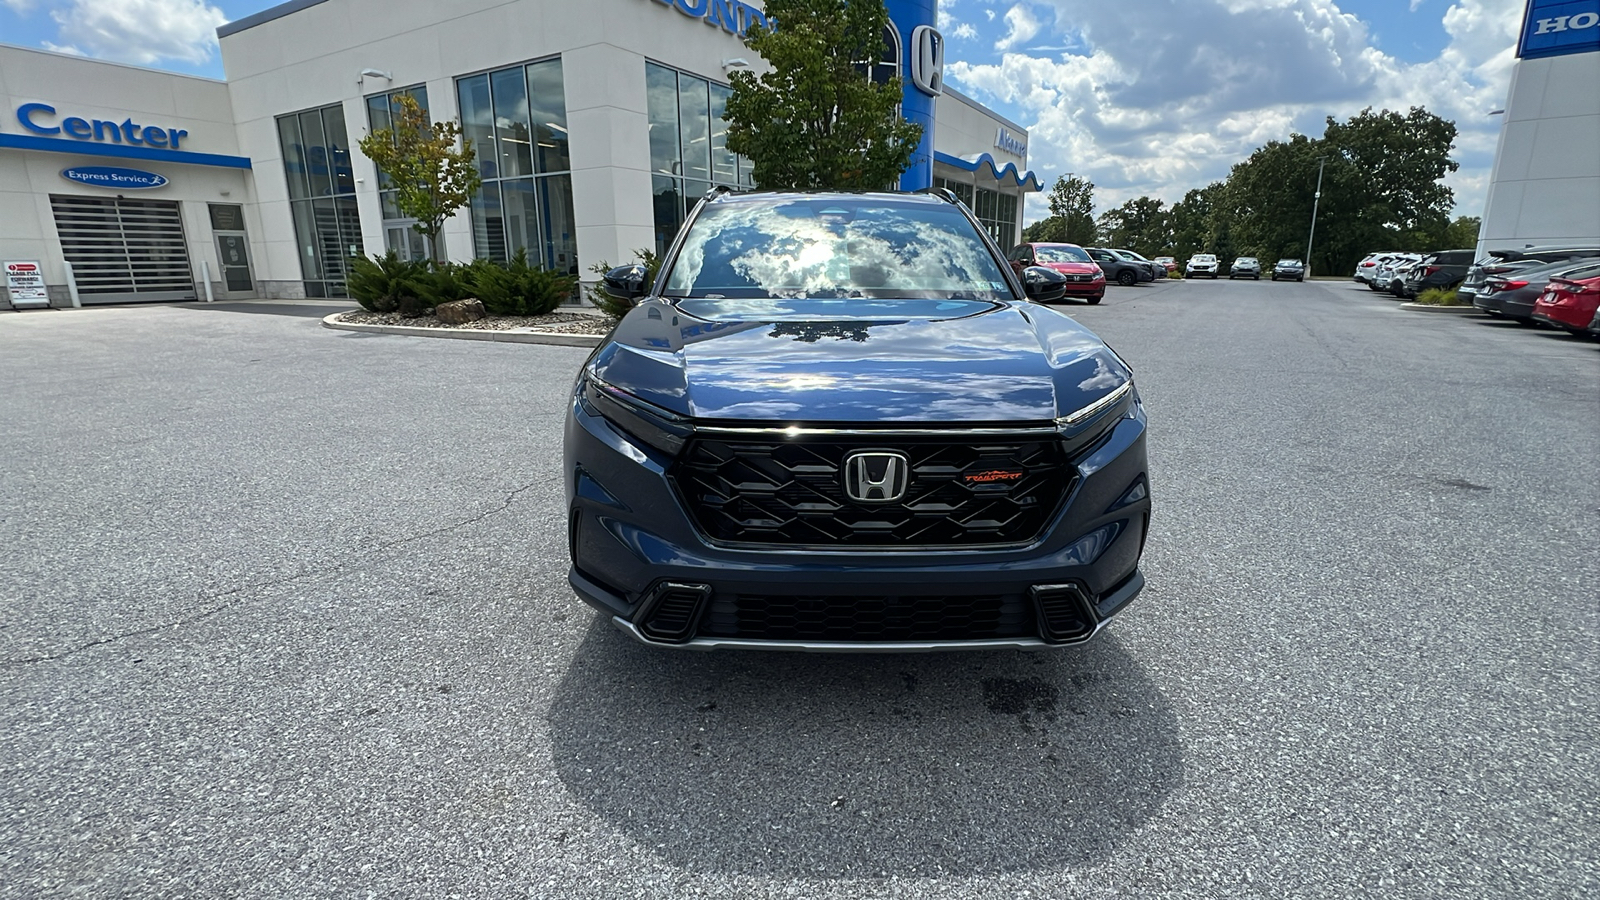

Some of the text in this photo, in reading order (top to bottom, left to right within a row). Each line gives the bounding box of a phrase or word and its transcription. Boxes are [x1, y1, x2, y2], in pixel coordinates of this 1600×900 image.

[650, 0, 779, 39] OND
[1534, 12, 1600, 35] HO
[16, 102, 188, 149] Center
[68, 170, 148, 183] Express Service
[965, 472, 1022, 482] TRAILSPORT
